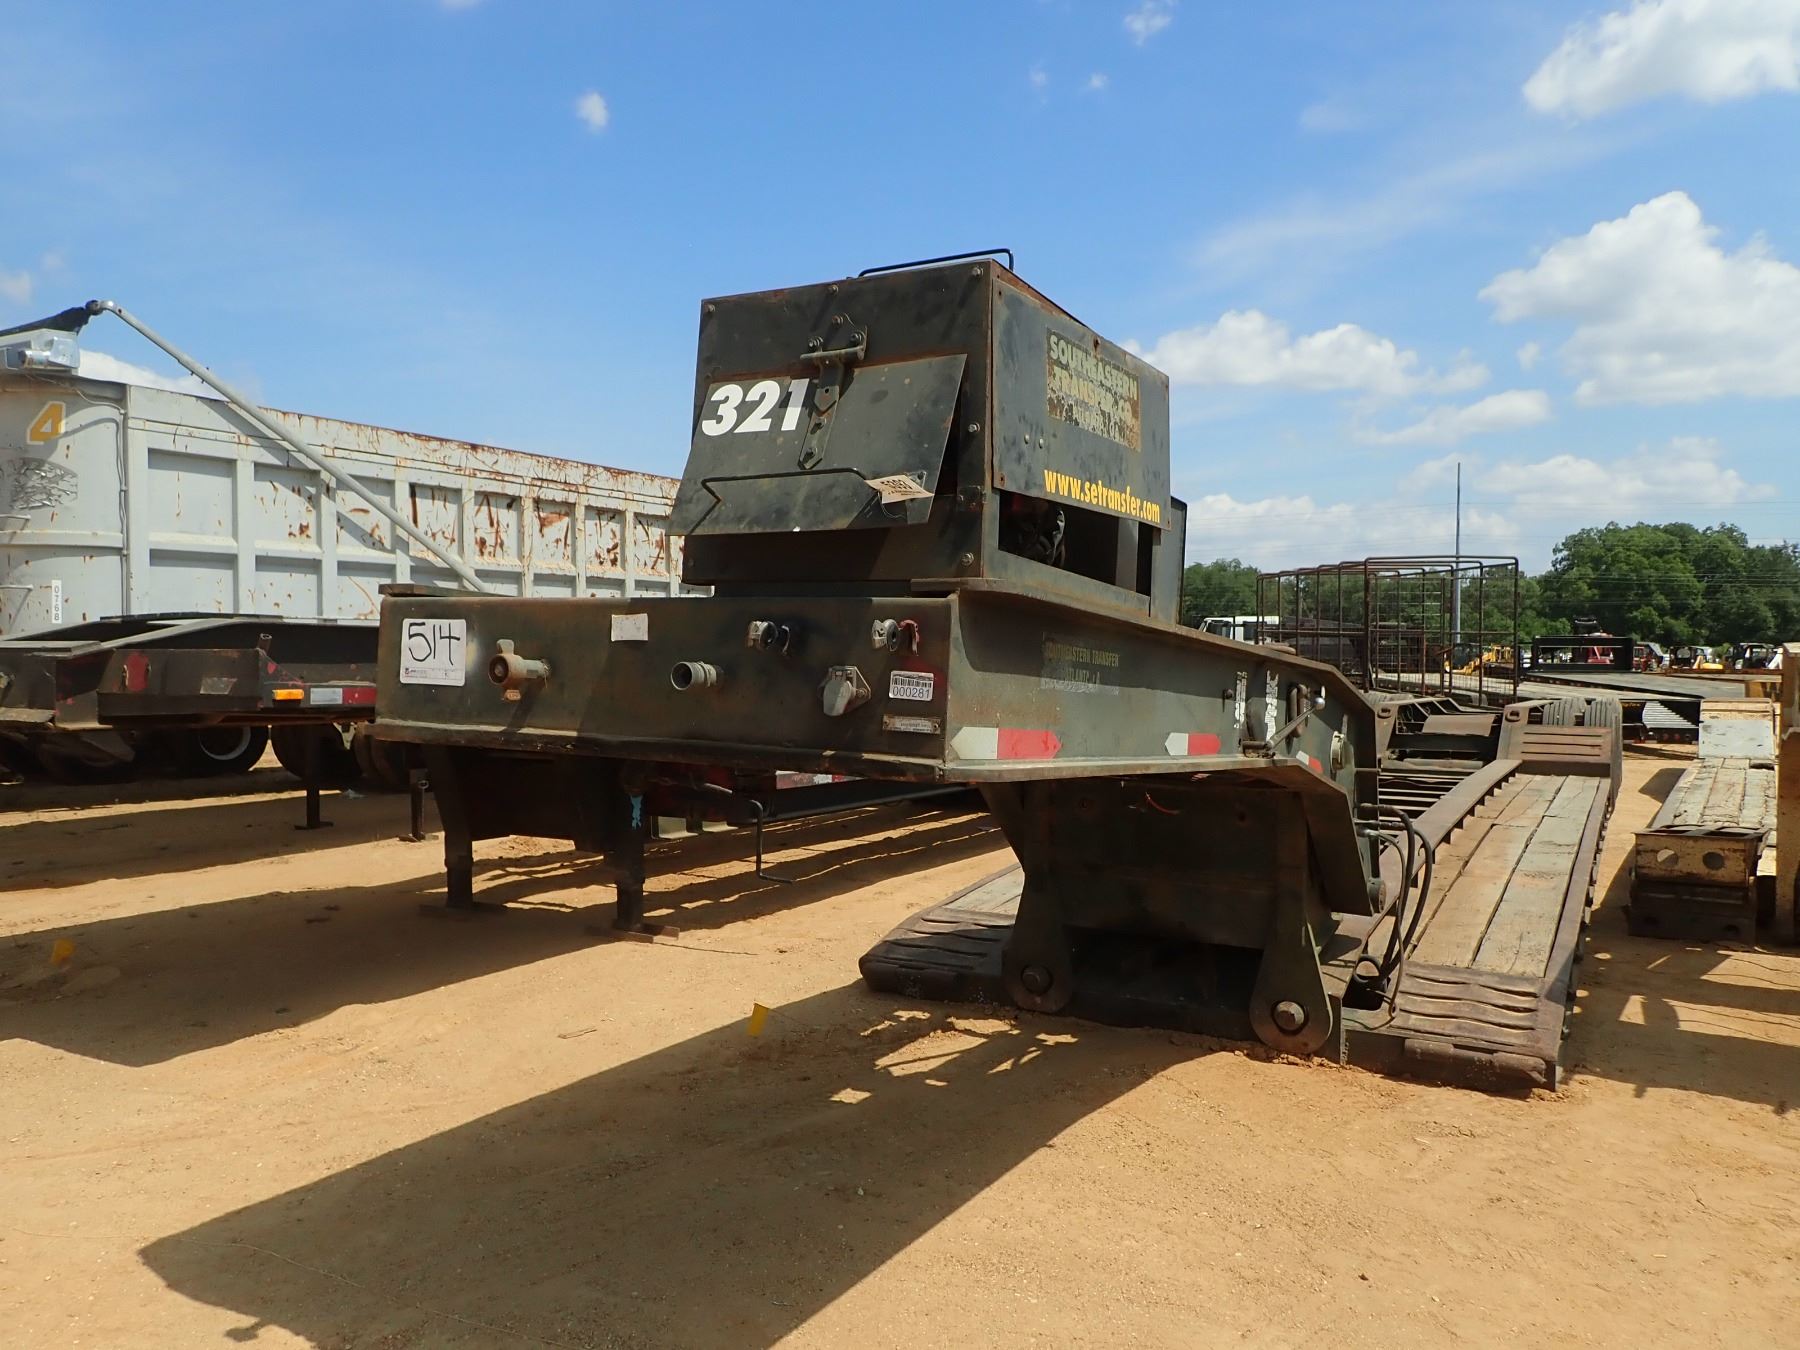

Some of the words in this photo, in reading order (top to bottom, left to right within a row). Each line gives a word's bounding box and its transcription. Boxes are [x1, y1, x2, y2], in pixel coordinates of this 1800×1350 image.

[26, 401, 66, 445] 4
[702, 379, 810, 437] 321
[1044, 469, 1160, 524] www.setransfer.com
[408, 622, 461, 666] 514
[892, 686, 930, 699] 000281
